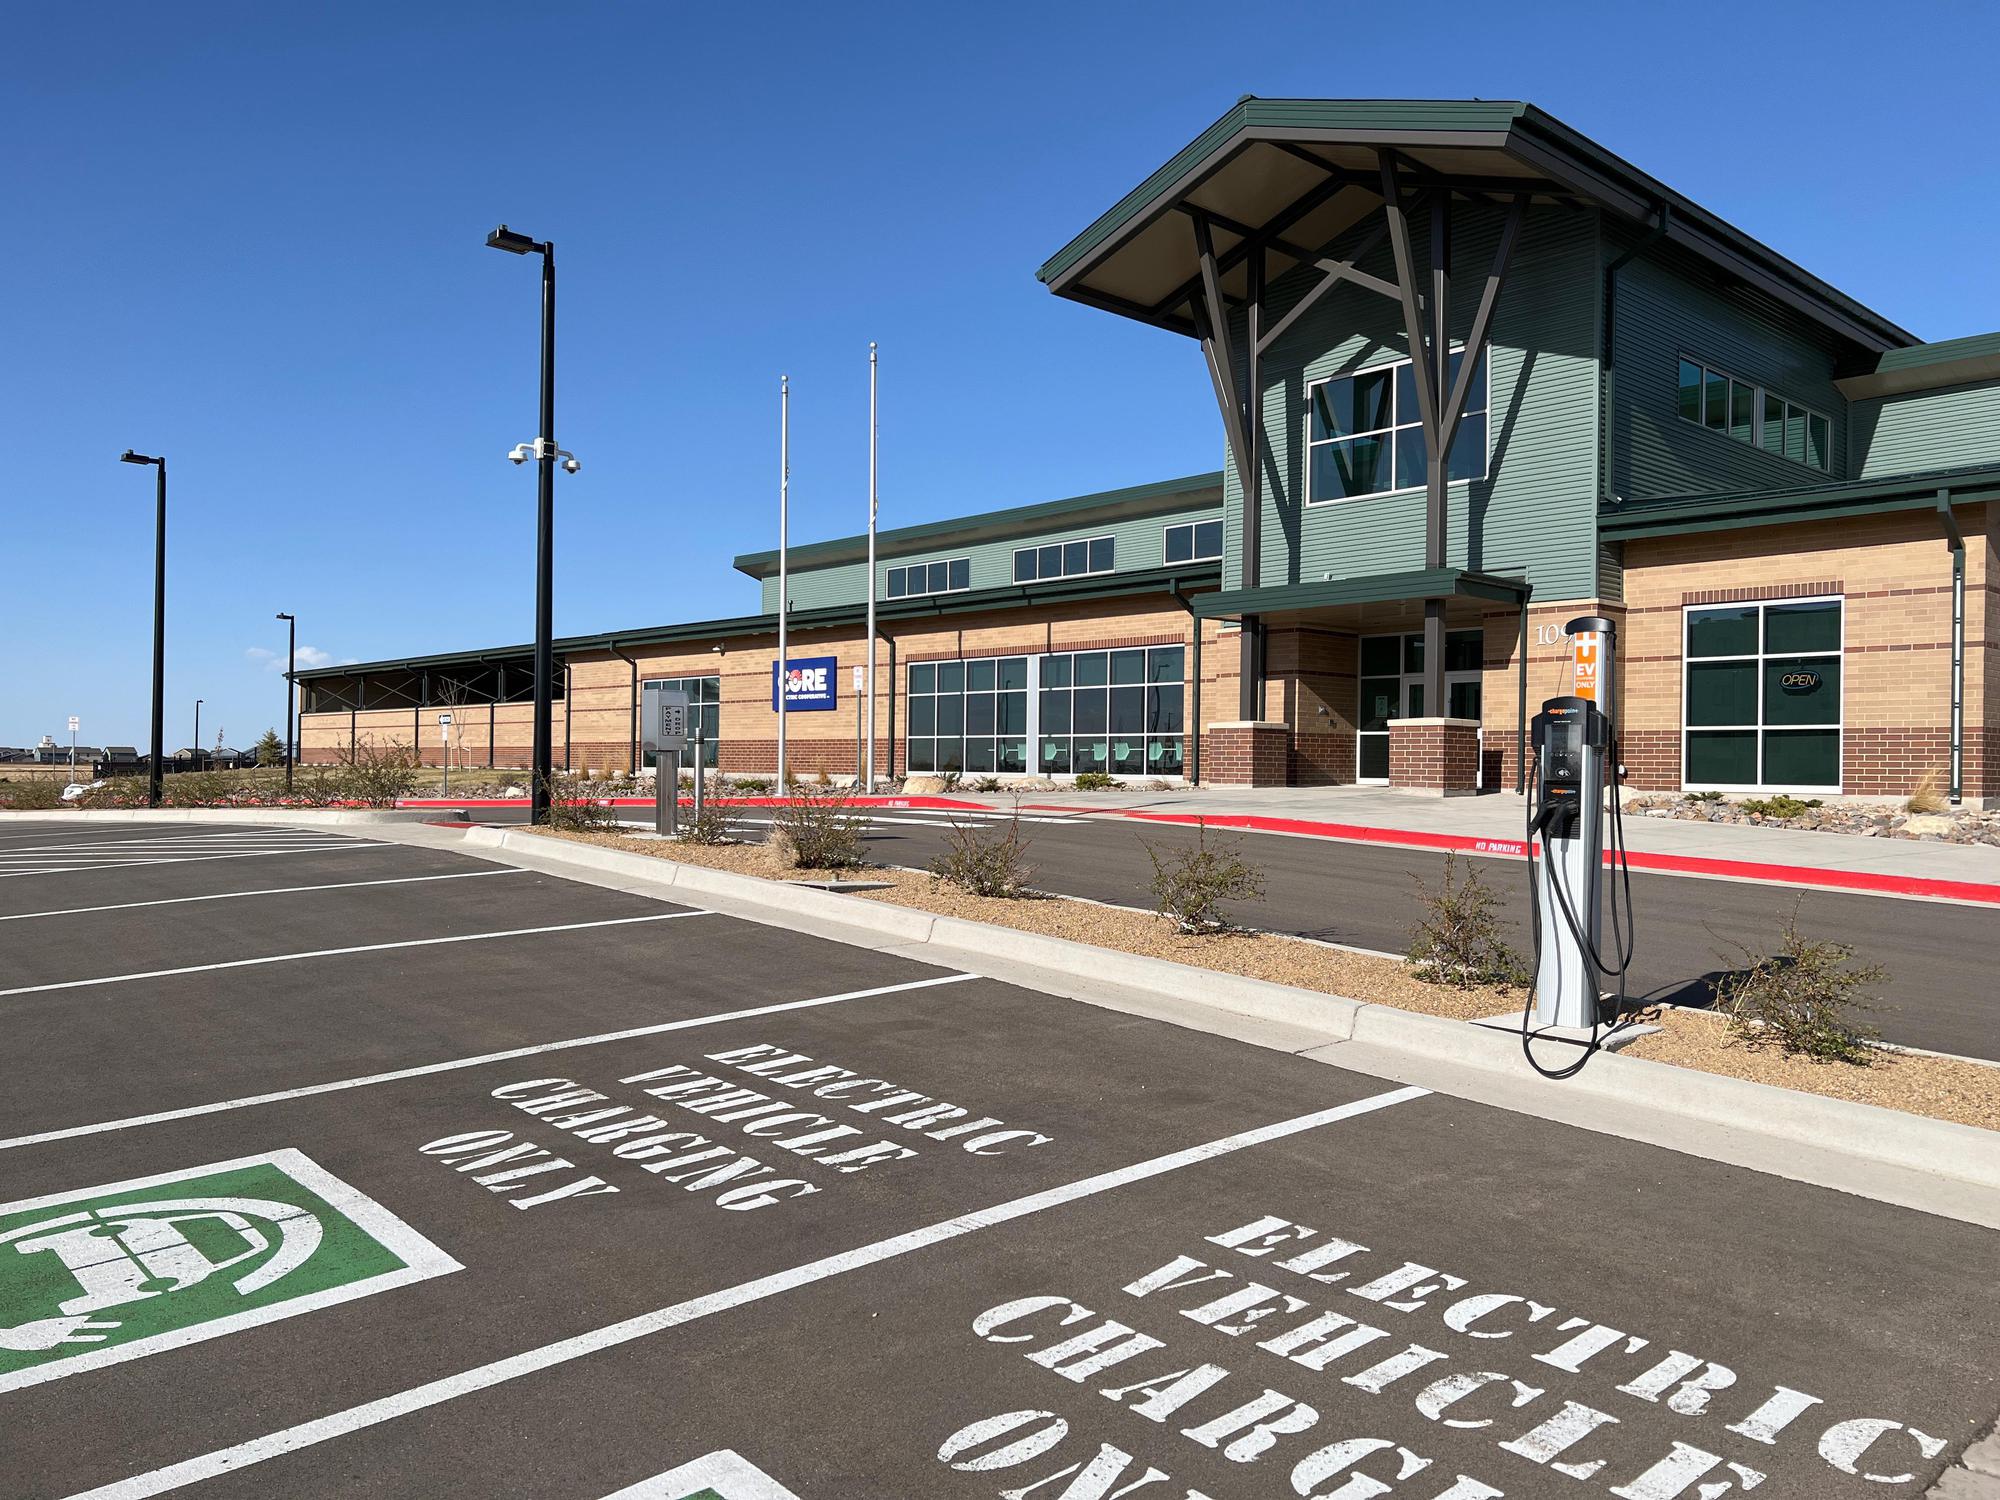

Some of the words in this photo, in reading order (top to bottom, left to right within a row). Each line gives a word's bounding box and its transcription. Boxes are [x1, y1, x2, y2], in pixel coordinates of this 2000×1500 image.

[778, 668, 827, 693] CORE
[1576, 663, 1595, 676] EV
[1782, 674, 1816, 686] OPEN
[1475, 842, 1486, 850] NO
[1488, 843, 1521, 854] PARKING
[490, 1078, 823, 1211] CHARGING
[618, 1064, 920, 1174] VEHICLE
[704, 1043, 1055, 1156] ELECTRIC
[418, 1130, 621, 1211] ONLY
[1121, 1254, 1768, 1500] VEHICLE
[1203, 1214, 1949, 1484] ELECTRIC
